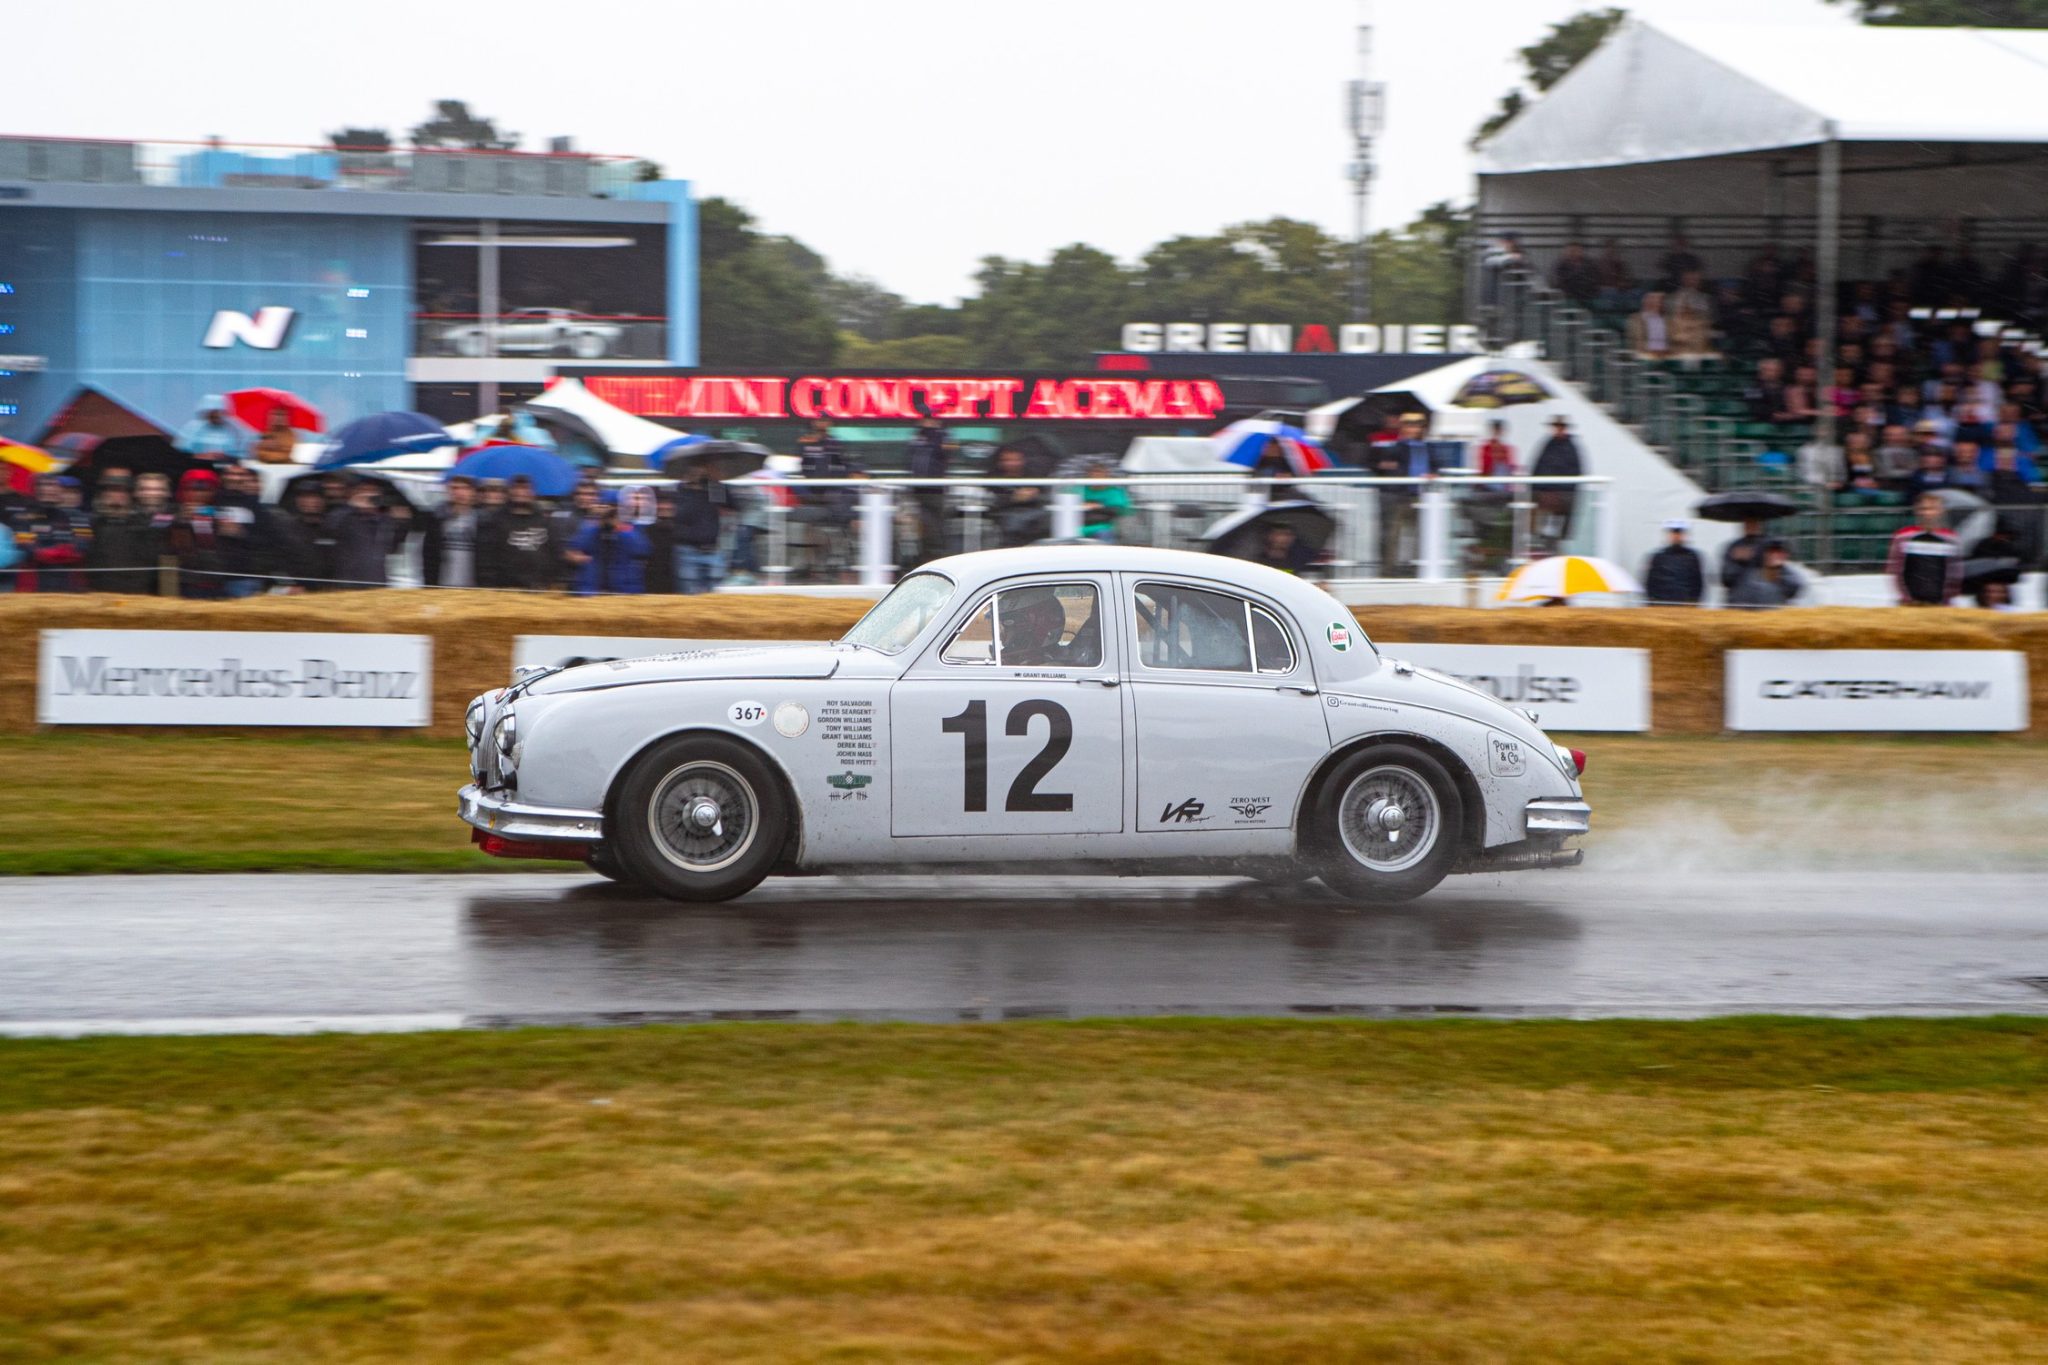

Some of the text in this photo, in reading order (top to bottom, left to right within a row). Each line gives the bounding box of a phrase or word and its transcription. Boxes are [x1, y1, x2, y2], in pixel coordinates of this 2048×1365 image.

[1121, 322, 1482, 353] GRENADIER
[790, 378, 1023, 418] CONCEPT
[55, 656, 418, 699] Mercedes-Benz
[1450, 663, 1582, 703] pulse
[735, 707, 762, 720] 367
[942, 699, 1073, 812] 12
[1492, 739, 1518, 752] POWER
[1500, 751, 1506, 761] &
